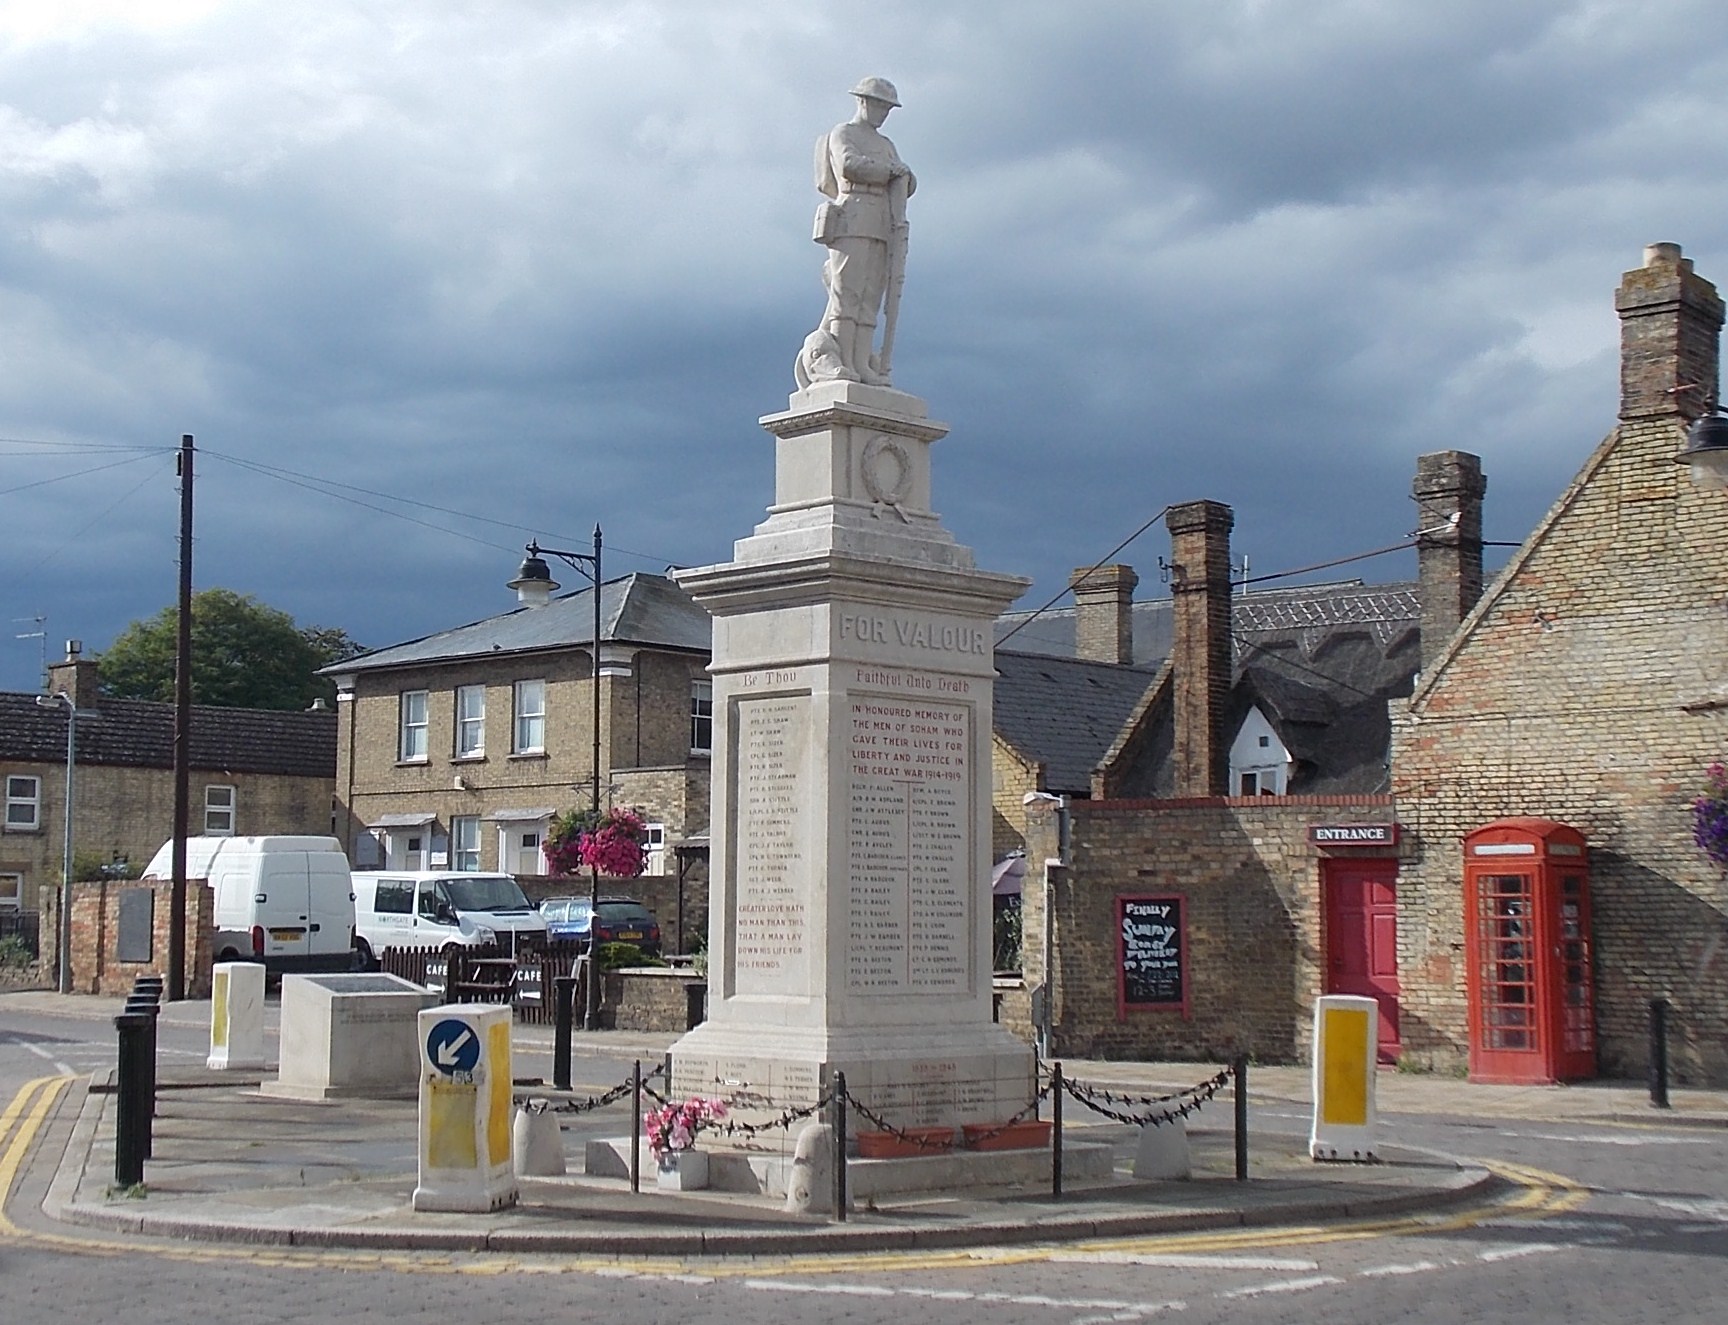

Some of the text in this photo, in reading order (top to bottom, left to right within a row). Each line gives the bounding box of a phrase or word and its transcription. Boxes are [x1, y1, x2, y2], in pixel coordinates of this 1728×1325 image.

[840, 612, 985, 655] FOR VALOUR
[743, 671, 797, 687] Be Thou
[856, 669, 900, 687] Faithful
[938, 677, 970, 693] Death
[852, 704, 964, 722] IN HONOURED MEMORY OF
[853, 719, 964, 737] THE MEN OF SOHAM WHO
[852, 735, 963, 751] GAVE THEIR LIVES FOR
[852, 751, 964, 766] LIBERTY AND JUSTICE IN
[853, 765, 961, 782] THE GREAT WAR 1914-1919
[1316, 828, 1385, 840] ENTRANCE
[738, 904, 805, 913] GREATER LOVE HATH
[738, 932, 758, 941] THAT
[768, 932, 784, 941] MAN
[786, 932, 802, 941] LAY
[760, 947, 771, 955] HIS
[772, 947, 787, 955] LIFE
[426, 964, 448, 976] CAFE
[517, 970, 541, 982] CAFE
